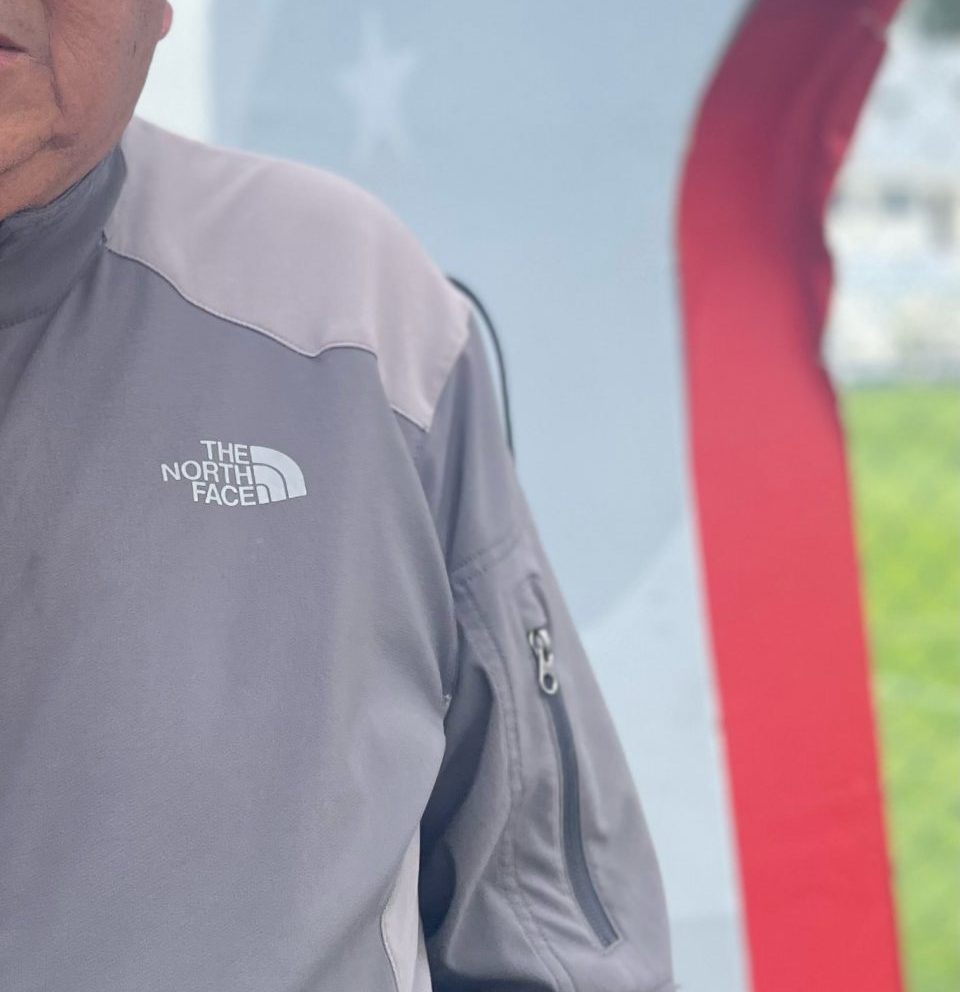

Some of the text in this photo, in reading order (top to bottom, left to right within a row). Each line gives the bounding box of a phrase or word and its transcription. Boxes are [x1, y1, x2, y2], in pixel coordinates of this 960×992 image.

[200, 439, 250, 465] THE
[160, 460, 254, 486] NORTH
[191, 481, 257, 507] FACE
